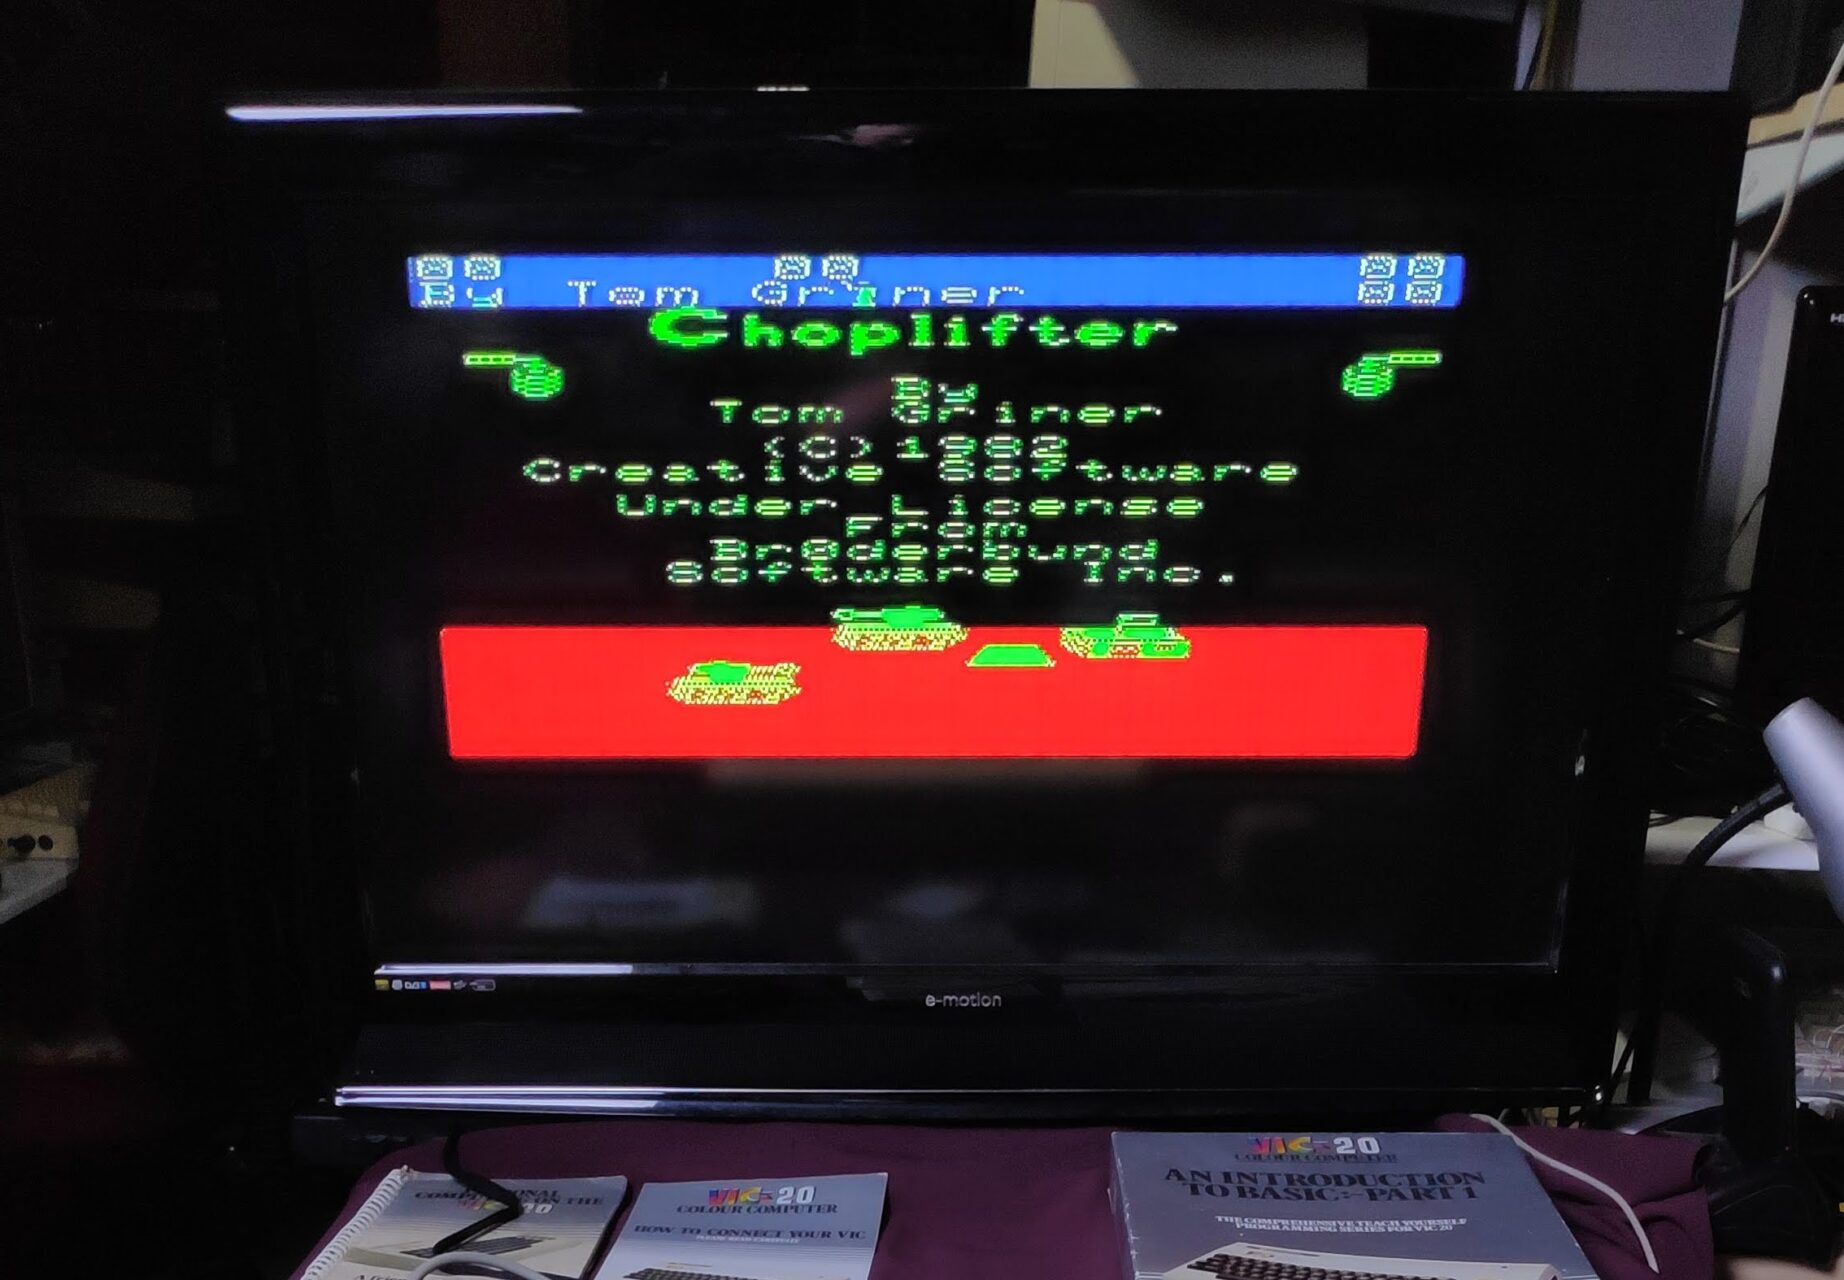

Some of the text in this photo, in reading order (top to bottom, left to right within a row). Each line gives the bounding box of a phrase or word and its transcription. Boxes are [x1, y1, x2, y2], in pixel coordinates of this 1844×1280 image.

[567, 280, 700, 307] Tom
[648, 305, 1179, 356] Choplifter
[711, 398, 1162, 424] Tom Griner
[522, 458, 1299, 483] Creative Software
[617, 494, 1204, 516] Under License
[925, 992, 1002, 1007] e-motion
[1164, 1169, 1486, 1188] AN INTRODUCTION
[1182, 1182, 1233, 1198] TO
[676, 1204, 839, 1215] COLOUR COMPUTER
[633, 1224, 867, 1240] HOW TO CONNECT YOUR VIC
